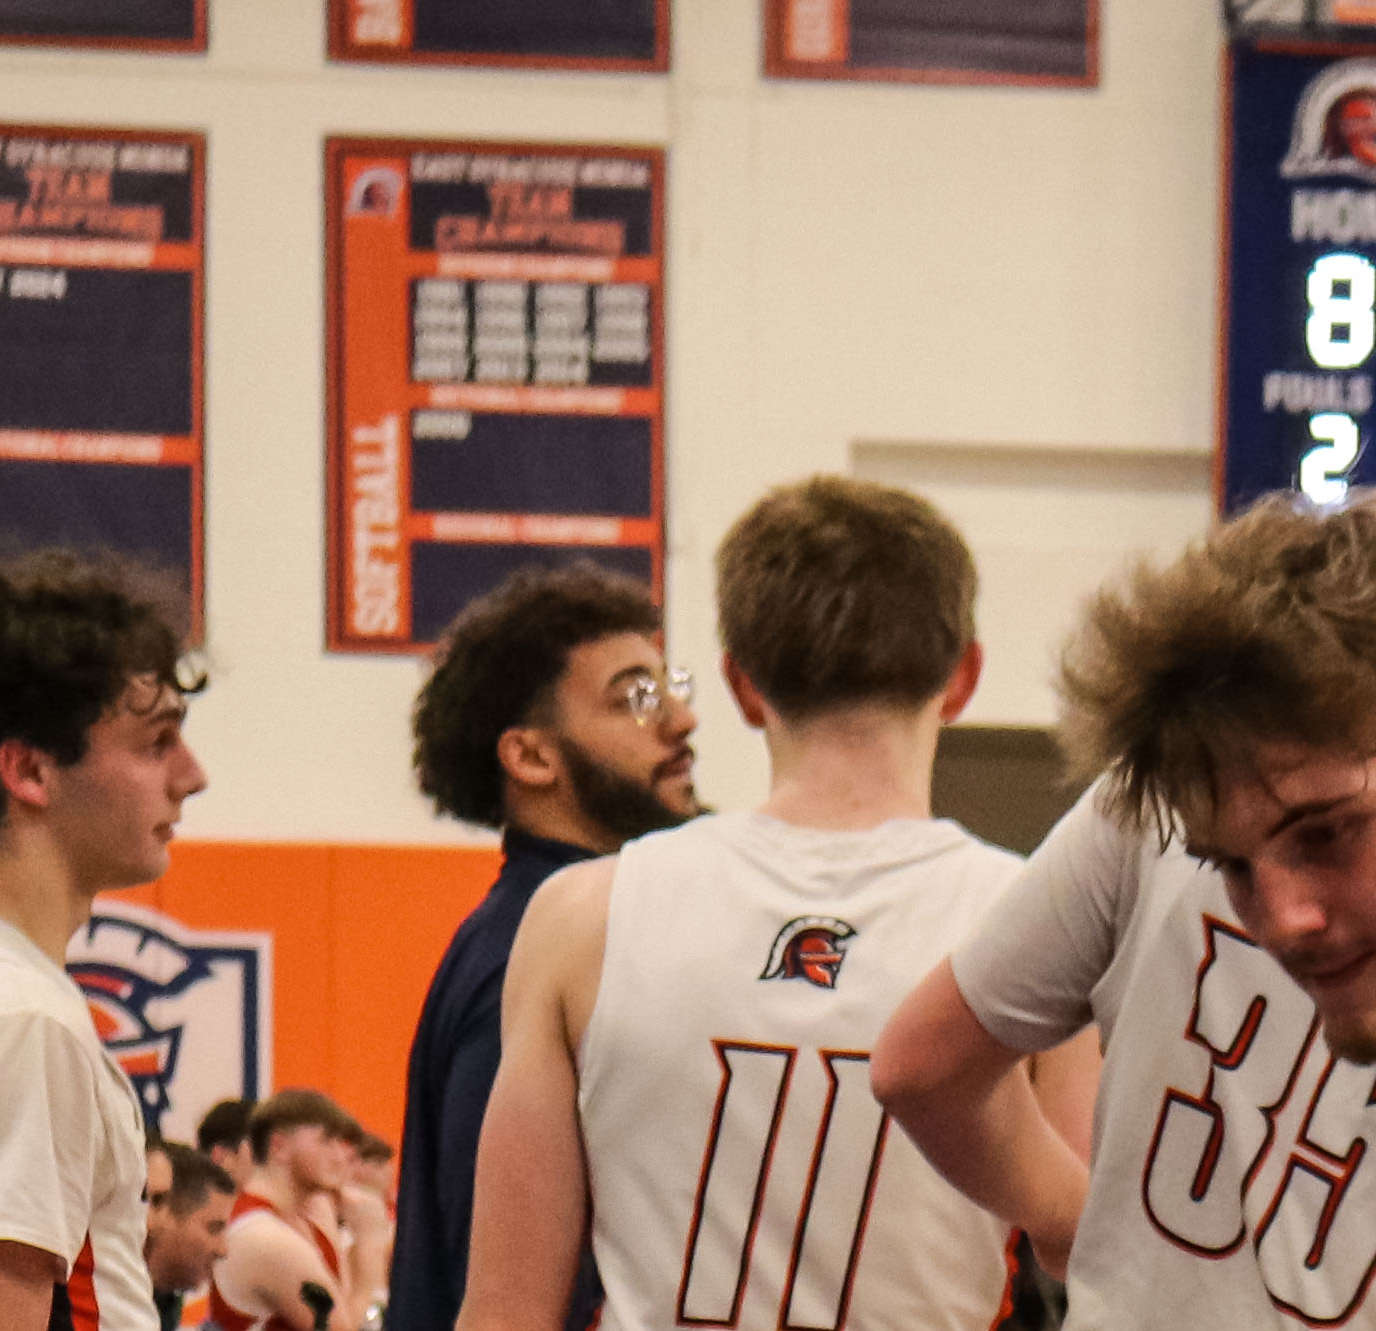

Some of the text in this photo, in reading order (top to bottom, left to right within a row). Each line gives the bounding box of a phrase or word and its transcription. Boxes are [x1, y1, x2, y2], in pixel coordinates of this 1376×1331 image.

[25, 168, 111, 202] TEAM
[1300, 411, 1360, 505] 2
[352, 413, 401, 635] SOFTBALL
